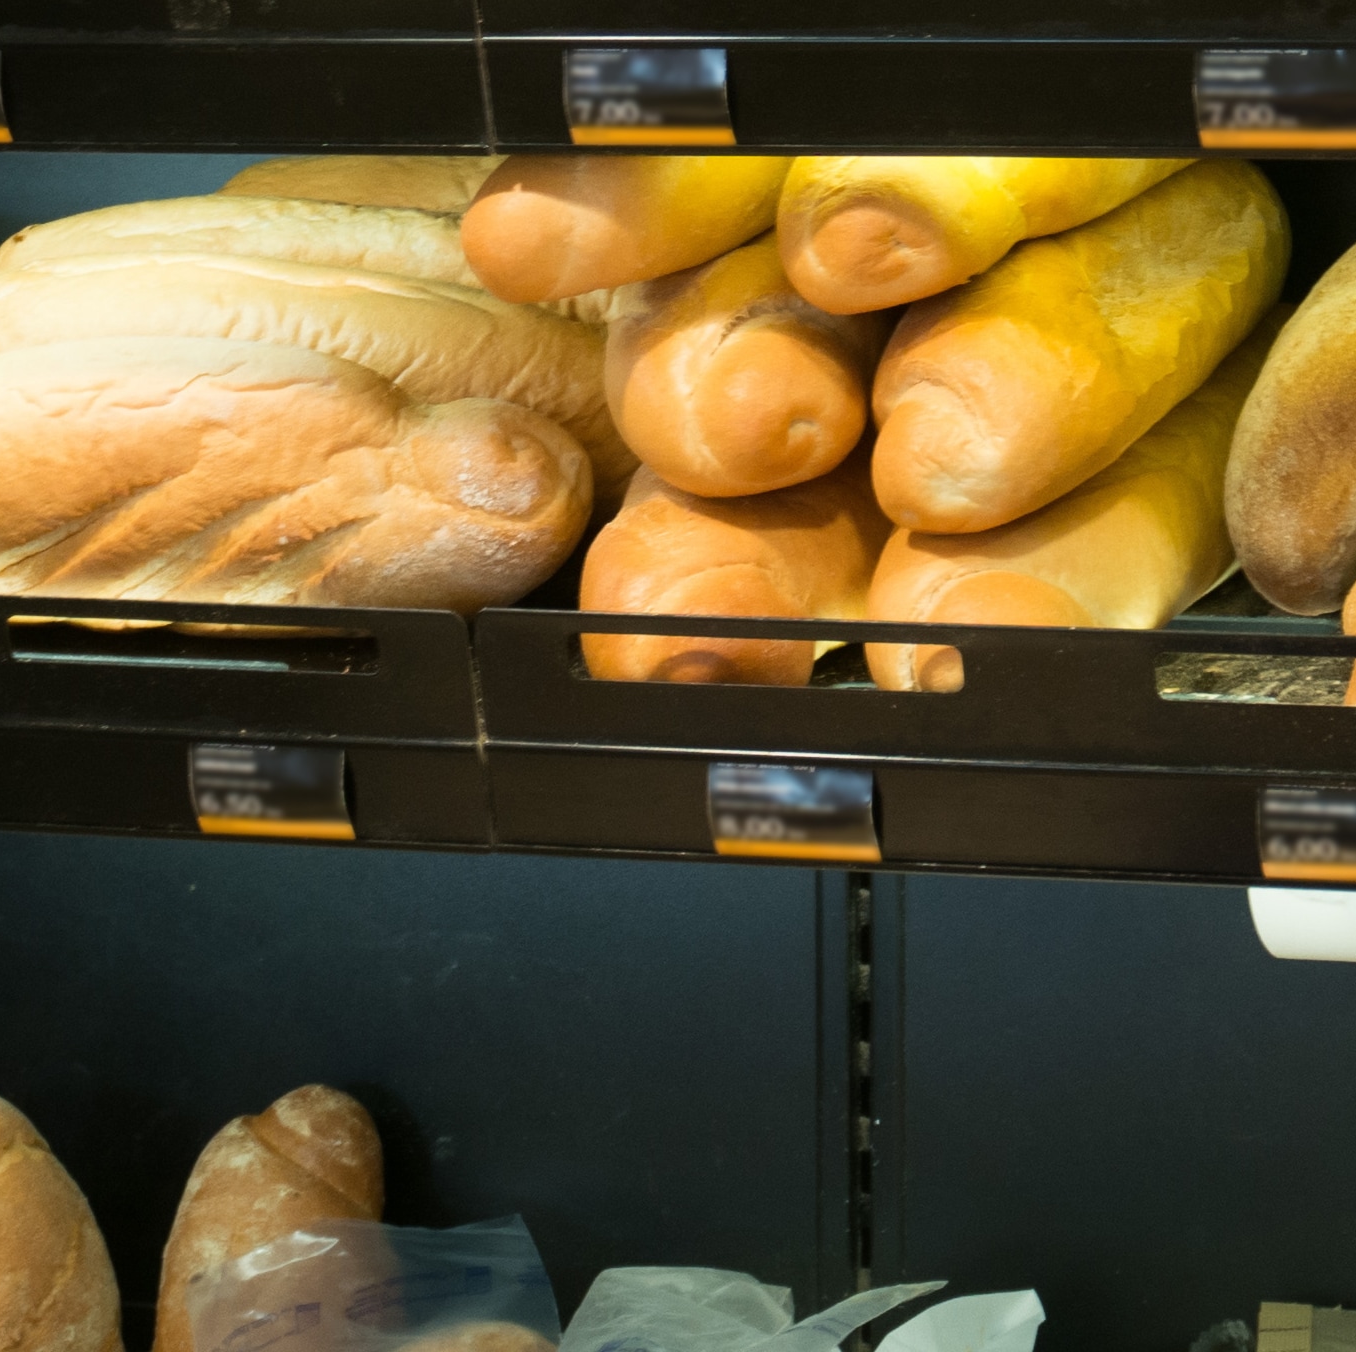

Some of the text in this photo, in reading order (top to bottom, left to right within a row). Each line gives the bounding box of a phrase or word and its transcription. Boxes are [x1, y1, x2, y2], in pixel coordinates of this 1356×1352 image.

[573, 101, 640, 128] 7,00
[1204, 103, 1275, 130] 7,00
[1267, 837, 1337, 865] 6,00
